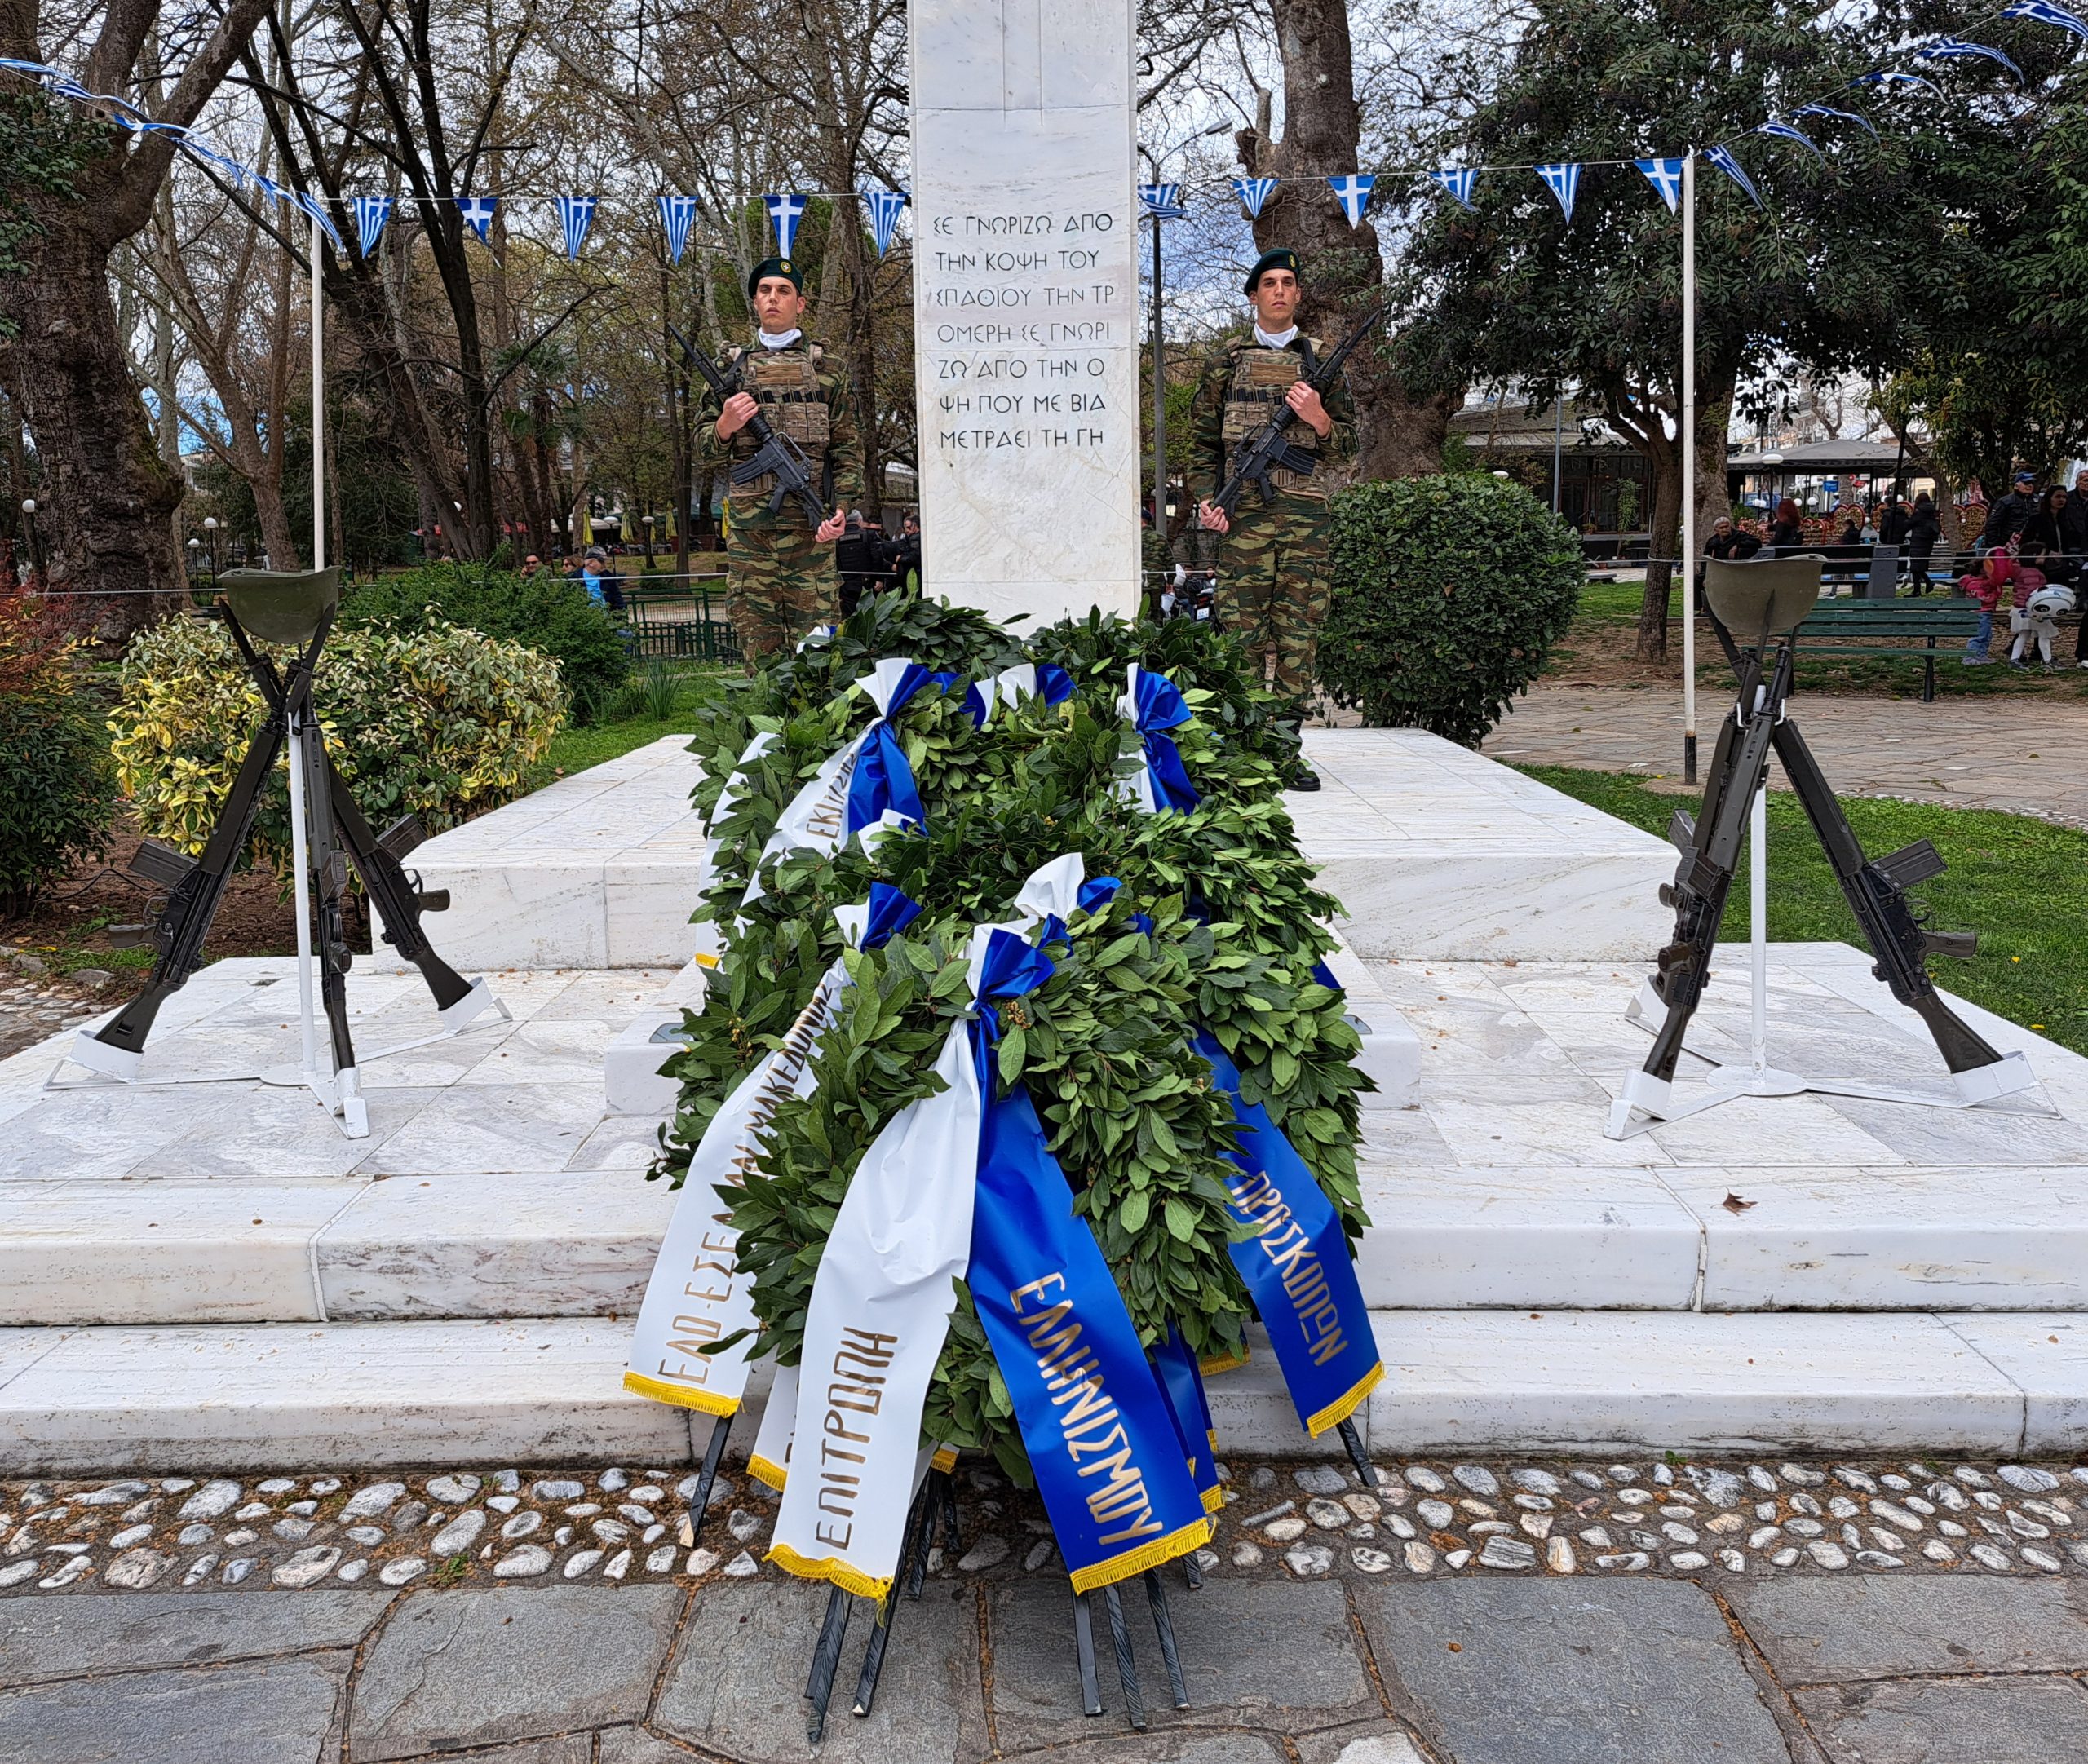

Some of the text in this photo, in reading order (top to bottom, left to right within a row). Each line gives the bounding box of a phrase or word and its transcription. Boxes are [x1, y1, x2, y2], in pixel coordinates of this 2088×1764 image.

[966, 215, 1051, 236] ΓΝΩΡΙΖΩ
[1064, 213, 1113, 232] ΑΠΟ
[935, 250, 1099, 272] ΤΗΝ ΚΟΨΗ ΤΟΥ
[1044, 287, 1084, 306] ΤΗΝ
[1092, 285, 1114, 304] ΤΡ
[937, 324, 1011, 343] ΟΜΕΡΗ
[1051, 321, 1109, 341] ΓΝΩΡΙ
[939, 358, 1105, 378] ΖΩ ΑΠΟ ΤΗΝ Ο
[939, 393, 1106, 413] ΨΗ ΠΟΥ ΜΕ ΒΙΑ
[940, 428, 1103, 449] ΜΕΤΡΑΕΙ ΤΗ ΓΗ
[815, 1271, 1164, 1550] ΕΠΙΤΡΟΠΗ ΕΛΛΗΝΙΣΜΟΥ
